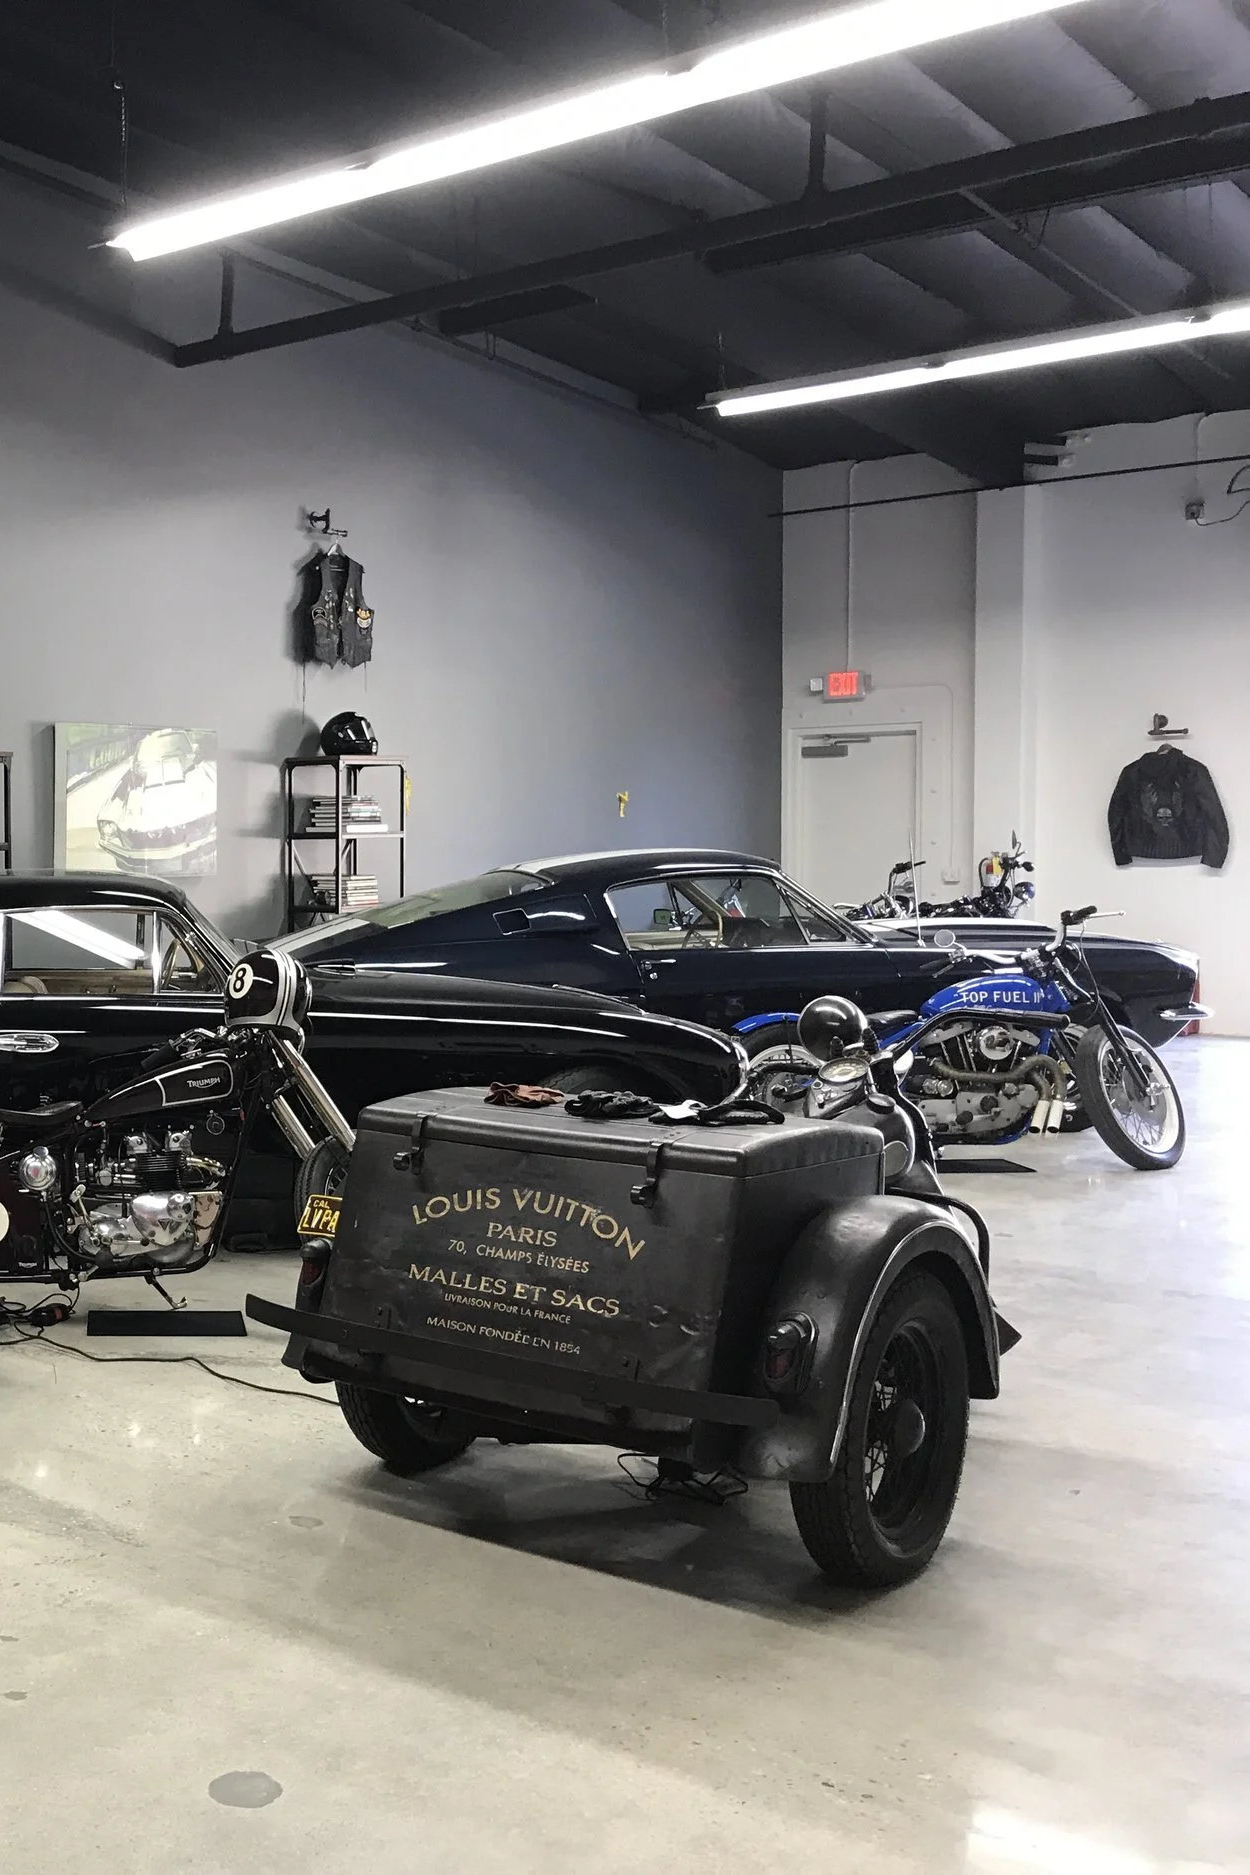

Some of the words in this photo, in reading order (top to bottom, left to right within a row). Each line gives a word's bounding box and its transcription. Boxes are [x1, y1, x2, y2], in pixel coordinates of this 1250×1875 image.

[233, 967, 247, 992] 8
[993, 991, 1030, 1003] FUEL
[187, 1077, 221, 1088] TRIUMPH
[313, 1200, 330, 1209] CAL
[411, 1187, 501, 1225] LOUIS
[513, 1187, 646, 1261] VUITTON
[486, 1221, 558, 1247] PARIS
[448, 1239, 467, 1256] 70,
[476, 1244, 532, 1264] CHAMPS
[408, 1263, 507, 1295] MALLES
[513, 1282, 546, 1303] ET
[551, 1289, 620, 1318] SACS
[444, 1293, 491, 1310] LIVRAISON
[493, 1302, 519, 1315] POUR
[520, 1306, 532, 1316] LA
[534, 1309, 571, 1325] FRANCE
[426, 1316, 476, 1336] MAISON
[533, 1336, 550, 1349] EN
[554, 1341, 581, 1355] 1854
